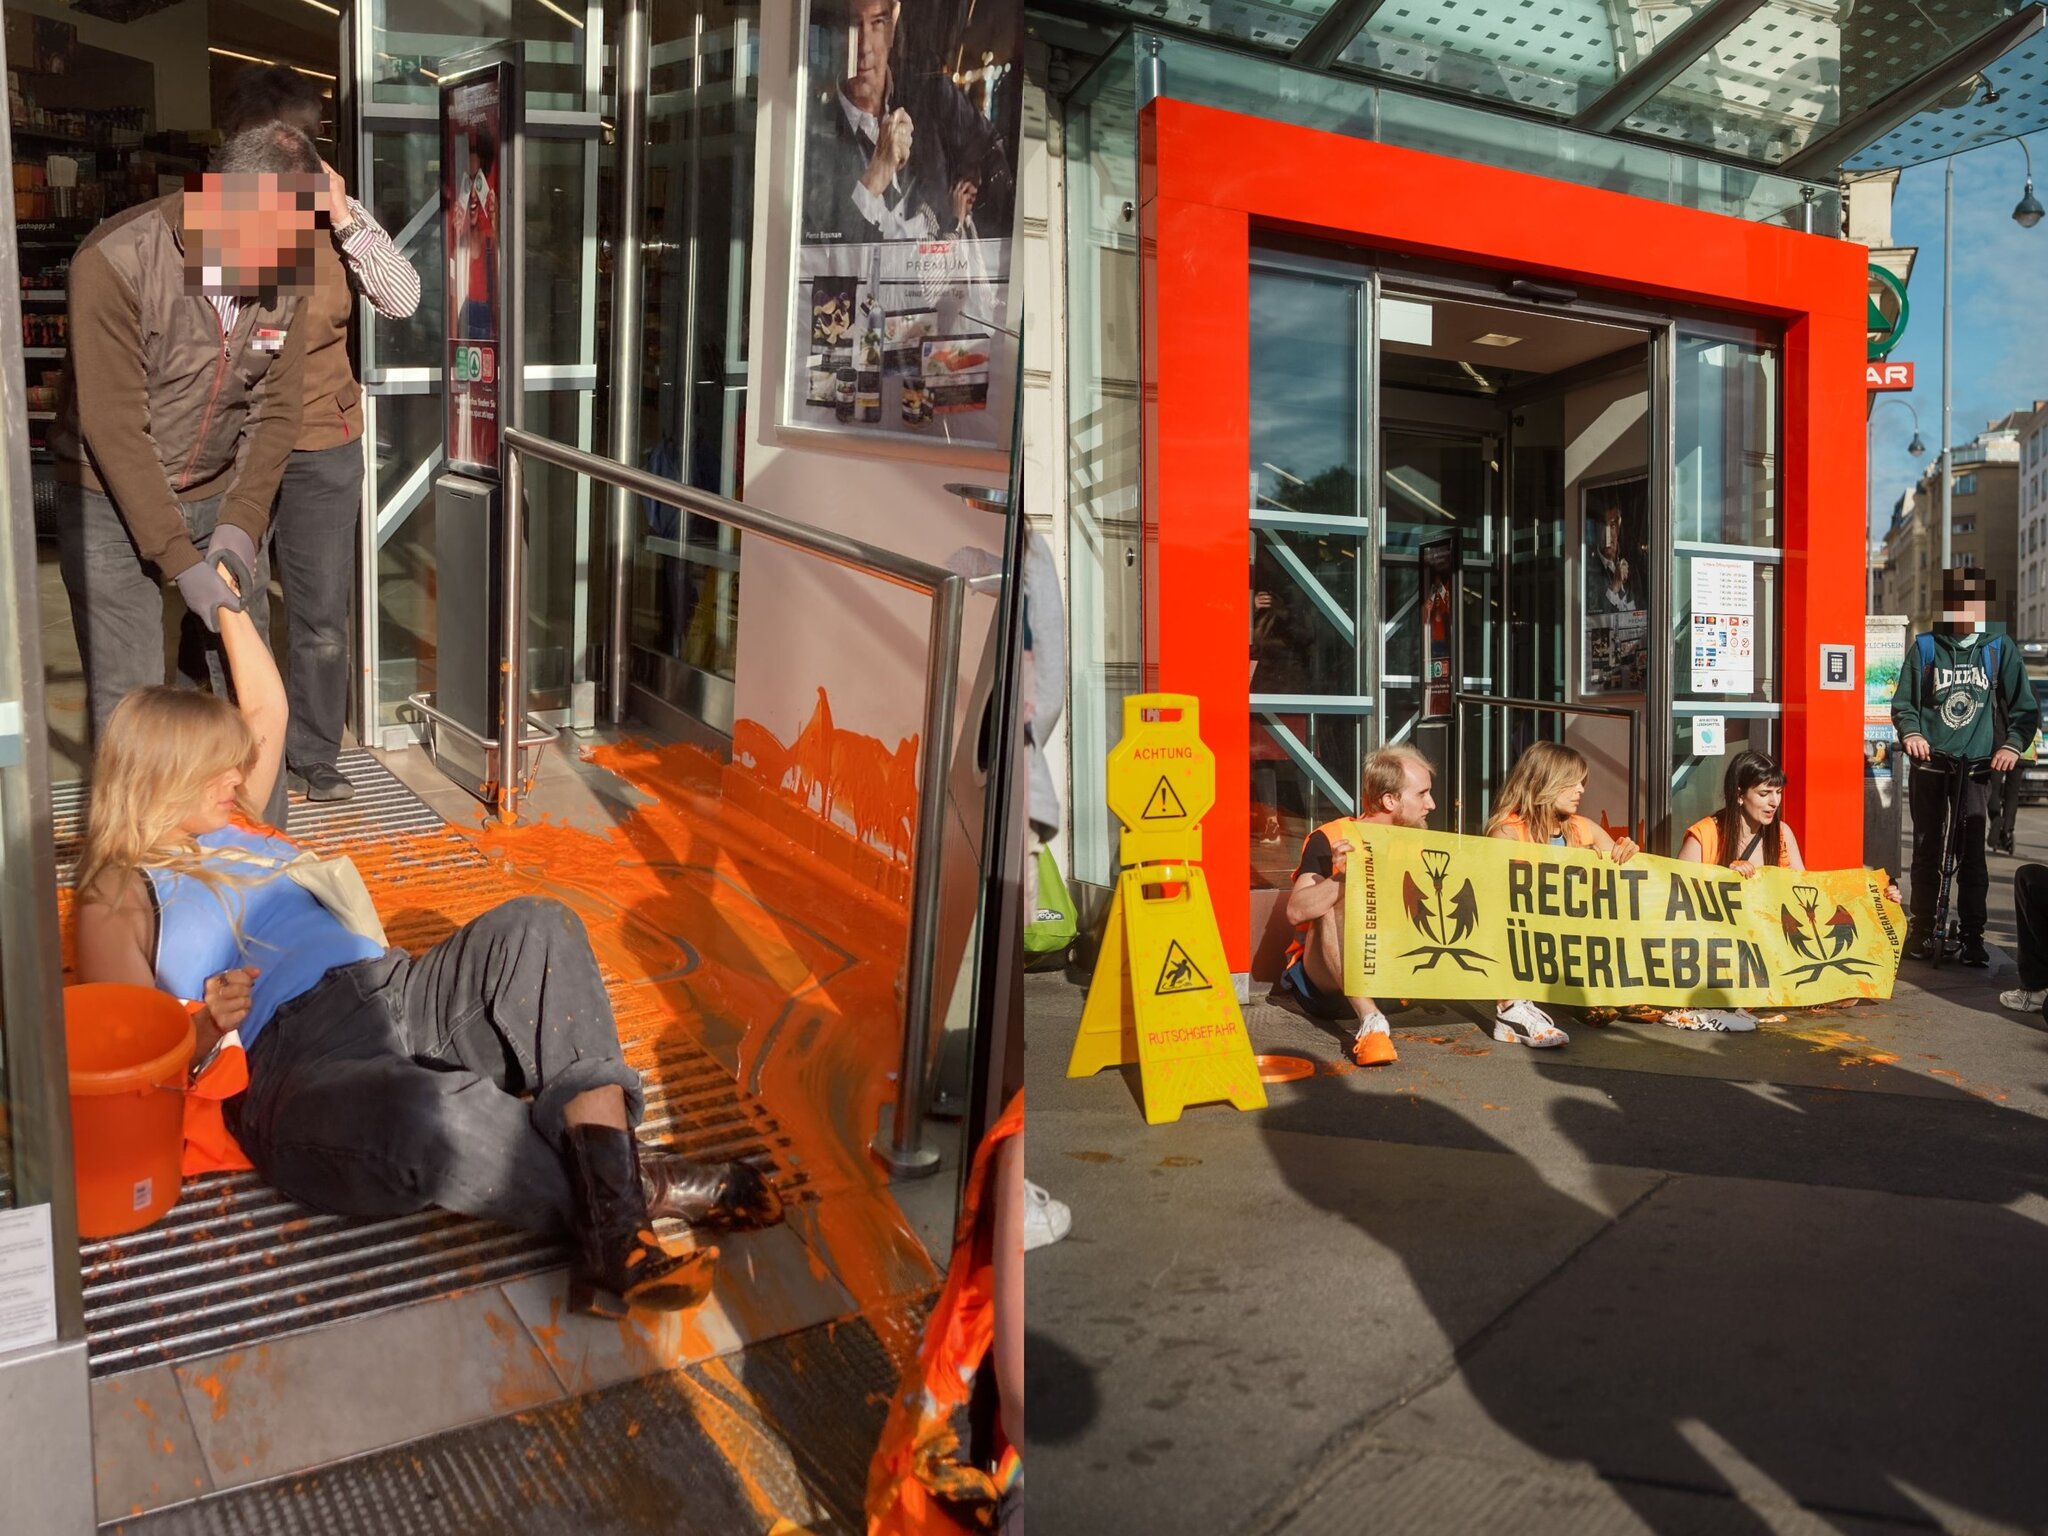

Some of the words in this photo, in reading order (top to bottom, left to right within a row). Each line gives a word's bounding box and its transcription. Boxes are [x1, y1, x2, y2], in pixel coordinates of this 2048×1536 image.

[1866, 366, 1908, 384] AR
[1134, 746, 1192, 760] ACHTUNG
[1362, 840, 1377, 930] GENERATION.AT
[1508, 859, 1648, 921] RECHT
[1665, 872, 1743, 926] AUF
[1869, 883, 1900, 946] GENERATION.AT
[1364, 933, 1377, 976] LETZTE
[1507, 918, 1770, 989] ÜBERLEBEN
[1148, 1022, 1237, 1045] RUTSCHGEFAHR
